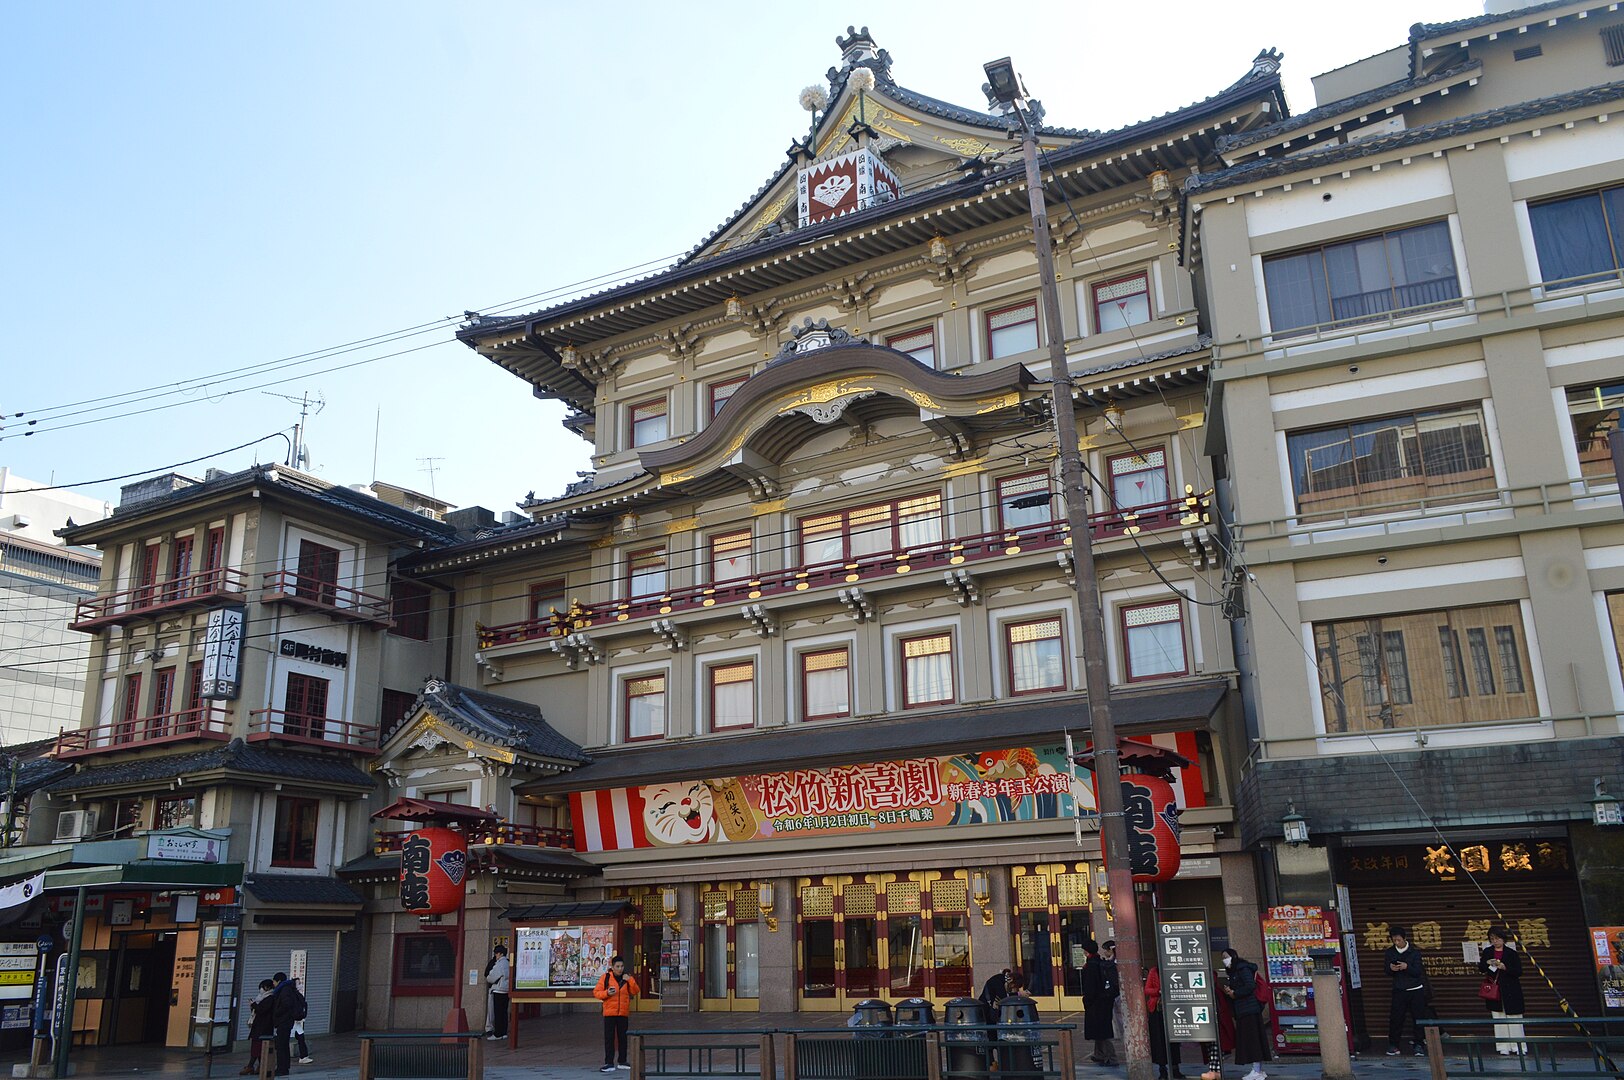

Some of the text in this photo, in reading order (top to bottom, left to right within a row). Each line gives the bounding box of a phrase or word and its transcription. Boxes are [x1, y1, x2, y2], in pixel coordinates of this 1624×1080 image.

[221, 614, 239, 677] 矢倉寿し
[283, 643, 295, 653] 4F
[203, 681, 214, 694] 3F
[217, 681, 233, 694] 3F
[759, 758, 942, 818] 松竹新喜劇
[947, 774, 1072, 802] 新春お年玉公演
[1120, 780, 1160, 876] 南座
[400, 833, 432, 911] 南座
